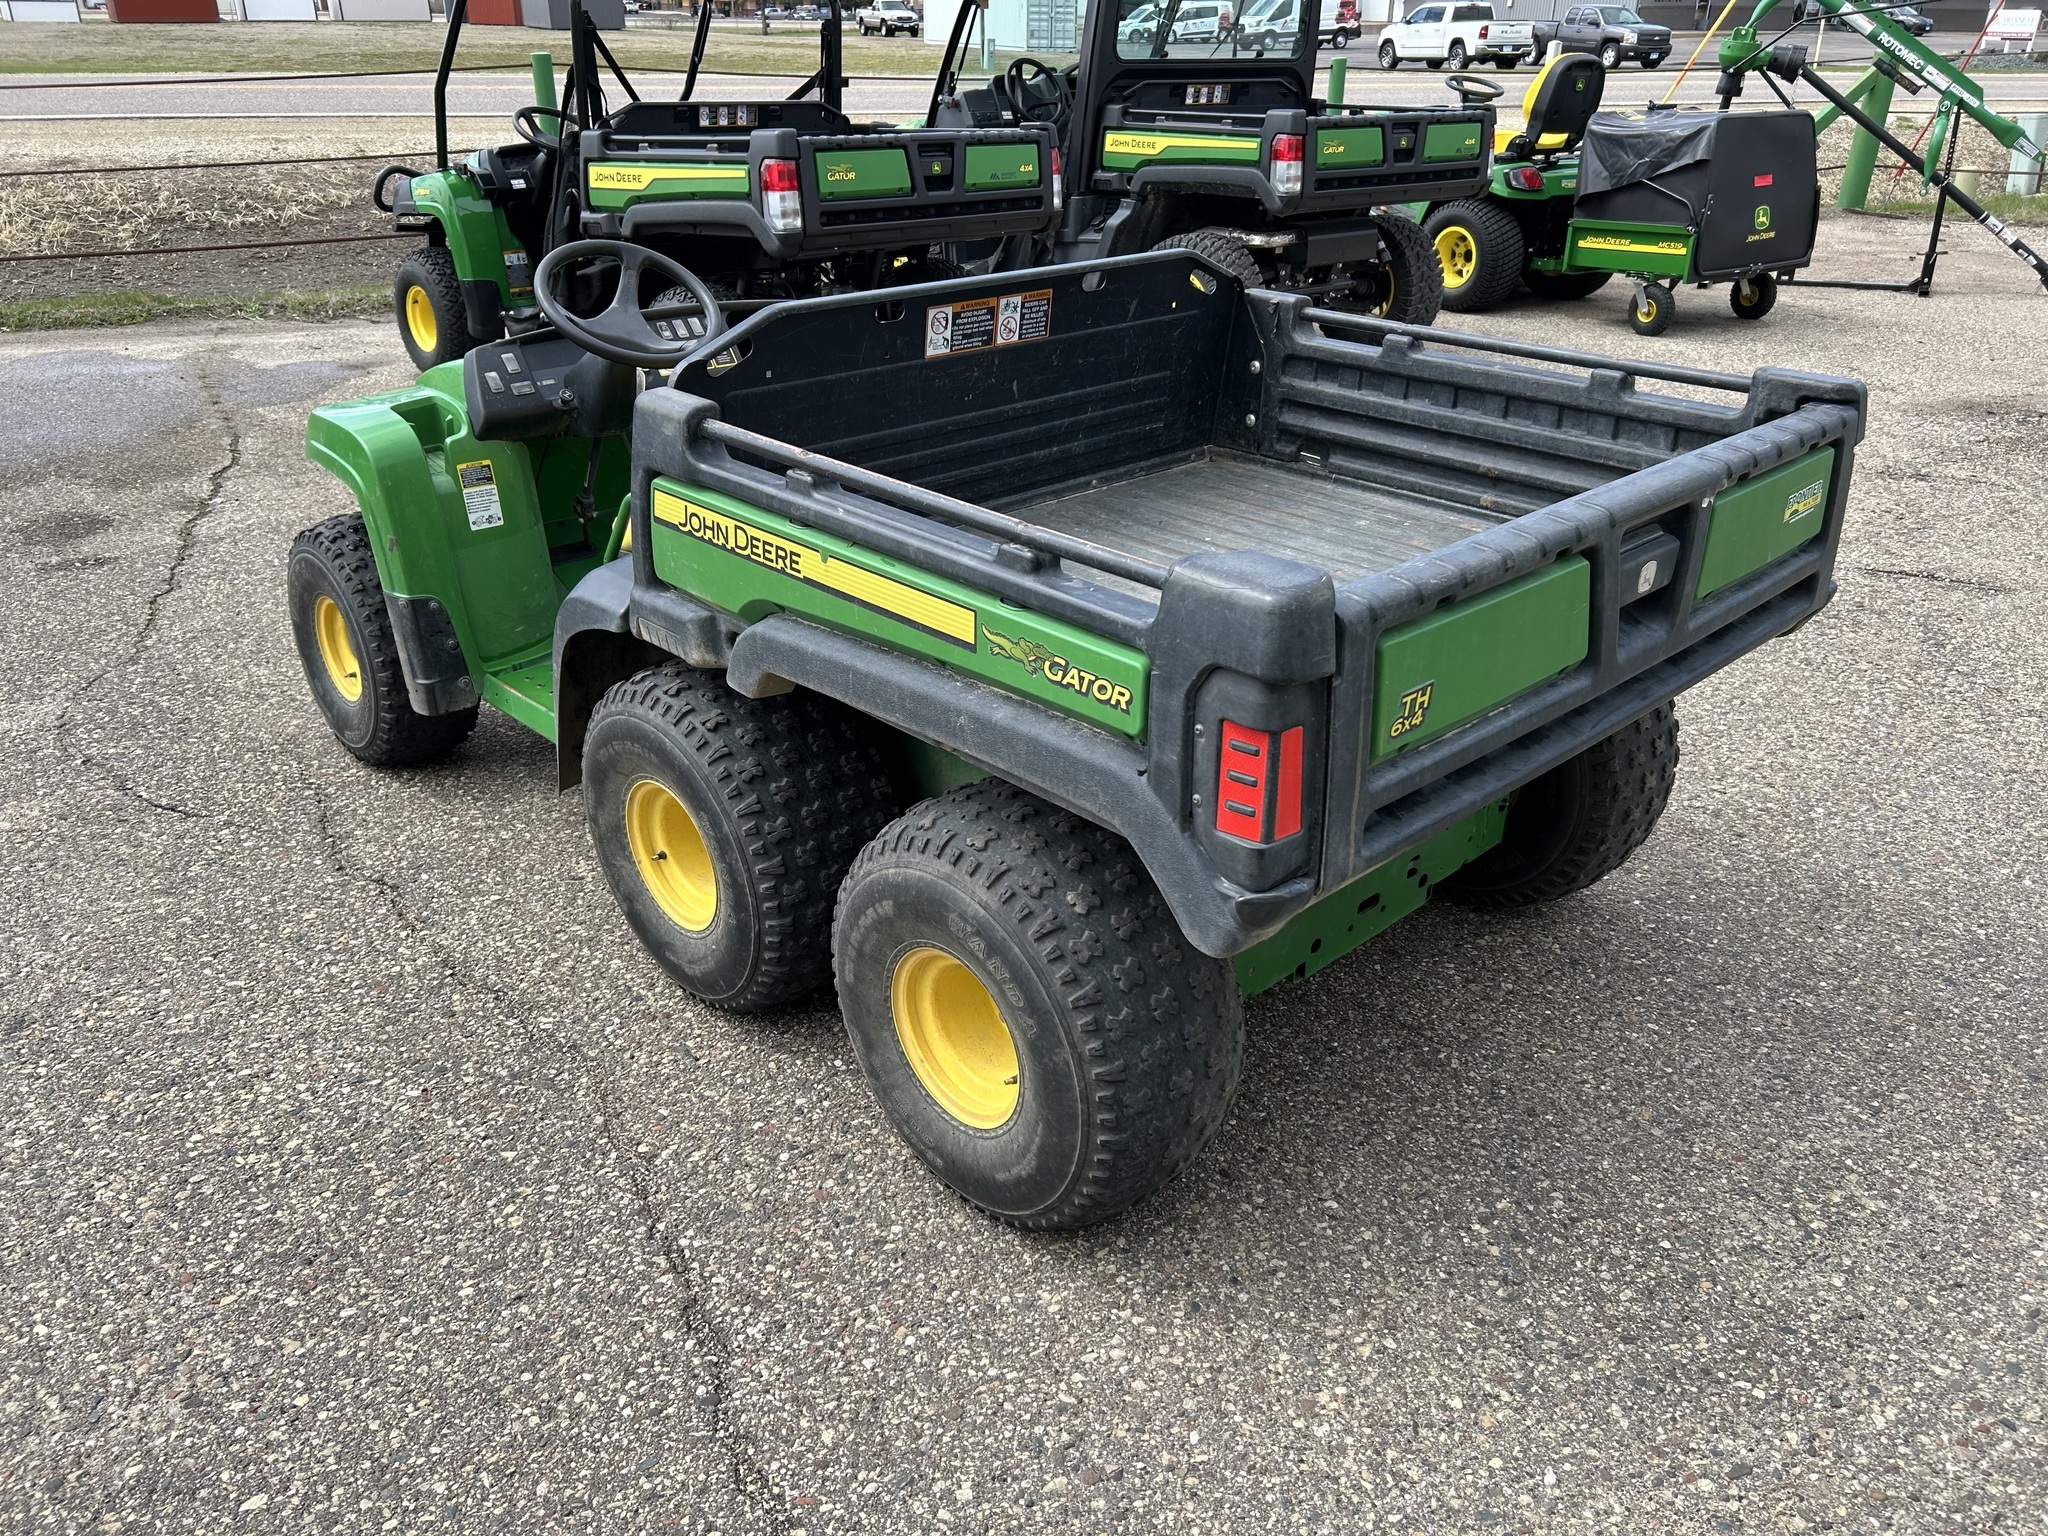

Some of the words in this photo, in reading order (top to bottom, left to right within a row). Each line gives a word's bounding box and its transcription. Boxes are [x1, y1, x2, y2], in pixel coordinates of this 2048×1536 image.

[1877, 32, 1924, 70] ROTOMEC
[1110, 138, 1130, 147] JOHN
[1131, 139, 1157, 149] DEERE
[1323, 146, 1345, 154] GATOR
[1019, 164, 1033, 172] 4x4
[594, 171, 615, 182] JOHN
[616, 172, 643, 183] DEERE
[827, 171, 856, 181] GATOR
[1760, 231, 1776, 240] DEERE
[1584, 235, 1604, 243] JOHN
[1605, 236, 1631, 246] DEERE
[1657, 241, 1683, 250] MC519
[1028, 291, 1051, 299] WARNING
[965, 300, 990, 309] WARNING
[678, 505, 728, 545] JOHN
[734, 524, 801, 574] DEERE
[1043, 655, 1132, 713] GATOR
[1402, 686, 1431, 717] TH
[1390, 709, 1423, 737] 6x4
[949, 912, 1037, 1038] WANDA
